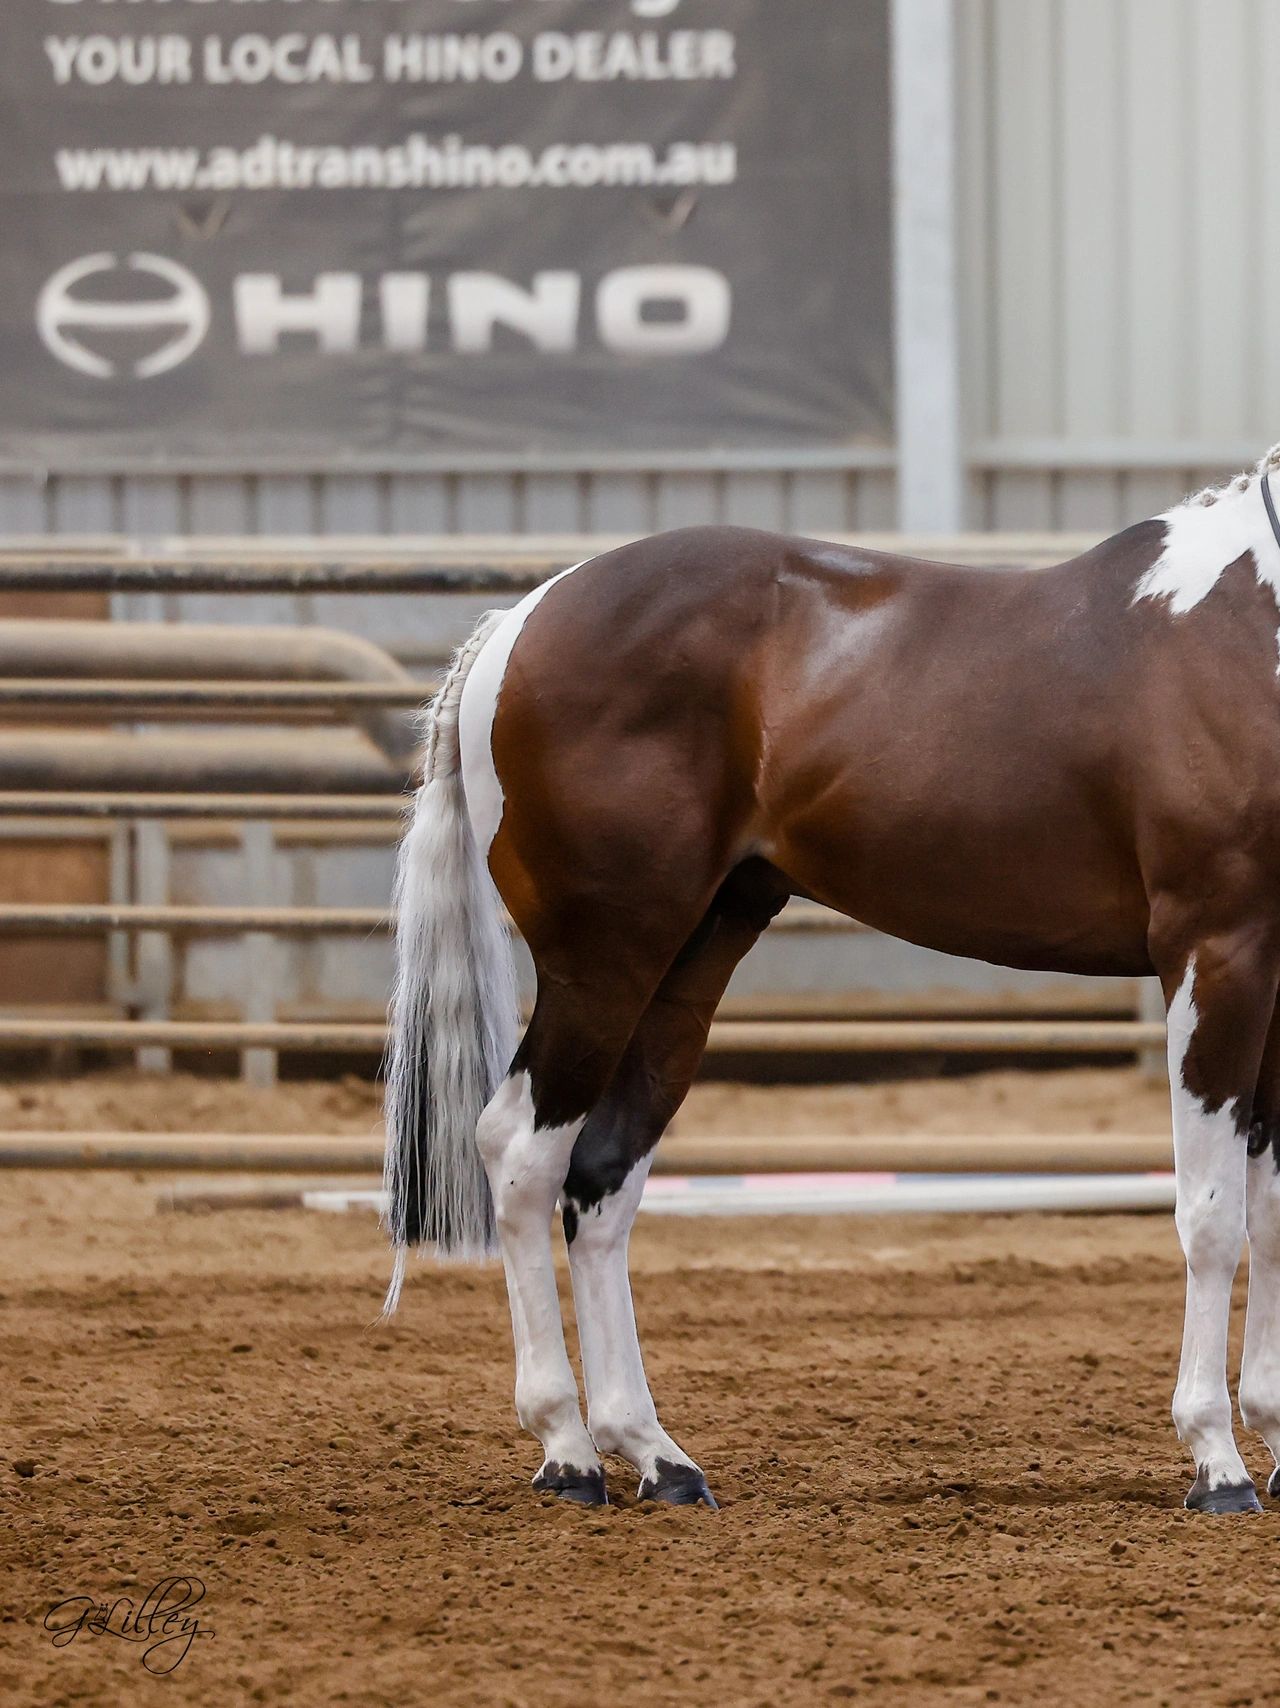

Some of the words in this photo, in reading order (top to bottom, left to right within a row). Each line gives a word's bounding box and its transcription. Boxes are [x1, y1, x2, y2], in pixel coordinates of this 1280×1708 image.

[46, 34, 193, 85] YOUR
[203, 32, 374, 84] LOCAL
[384, 31, 523, 83] HINO
[532, 28, 736, 82] DEALER
[55, 133, 736, 190] www.adtranshino.com.au
[233, 263, 731, 355] HINO
